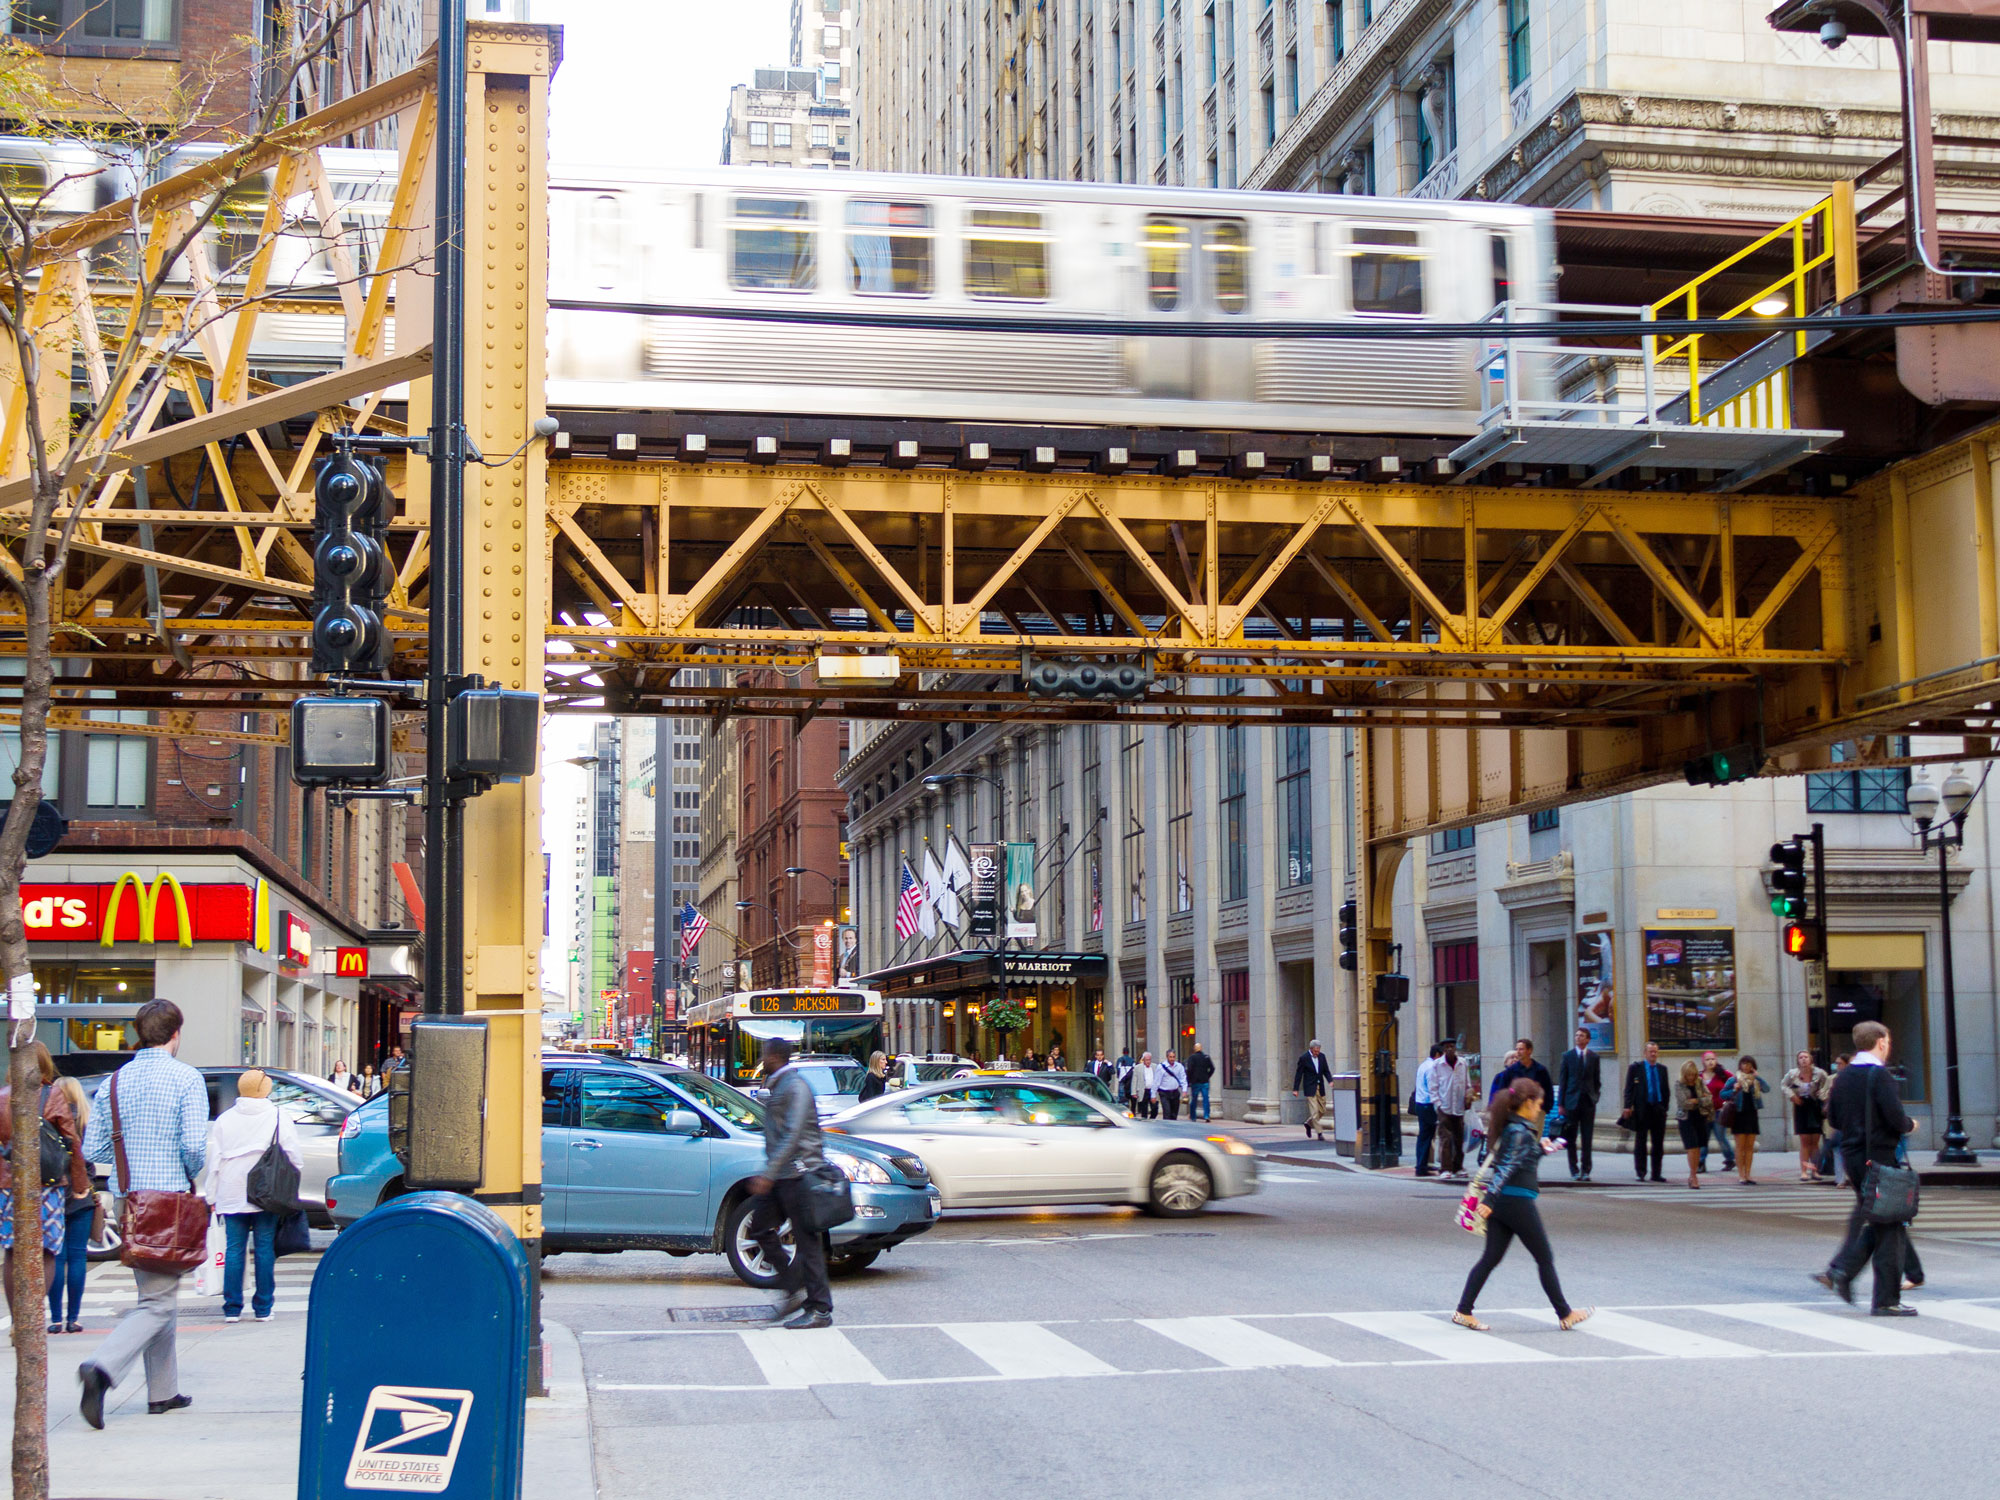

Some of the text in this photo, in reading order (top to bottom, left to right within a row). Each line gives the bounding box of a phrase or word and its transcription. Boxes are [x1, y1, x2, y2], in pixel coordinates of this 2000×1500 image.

[19, 896, 87, 928] d's
[1017, 962, 1072, 972] MARRIOTT
[760, 996, 839, 1012] 126 JACKSON
[358, 1459, 439, 1471] UNITED STATES
[354, 1471, 442, 1483] POSTAL SERVICE
